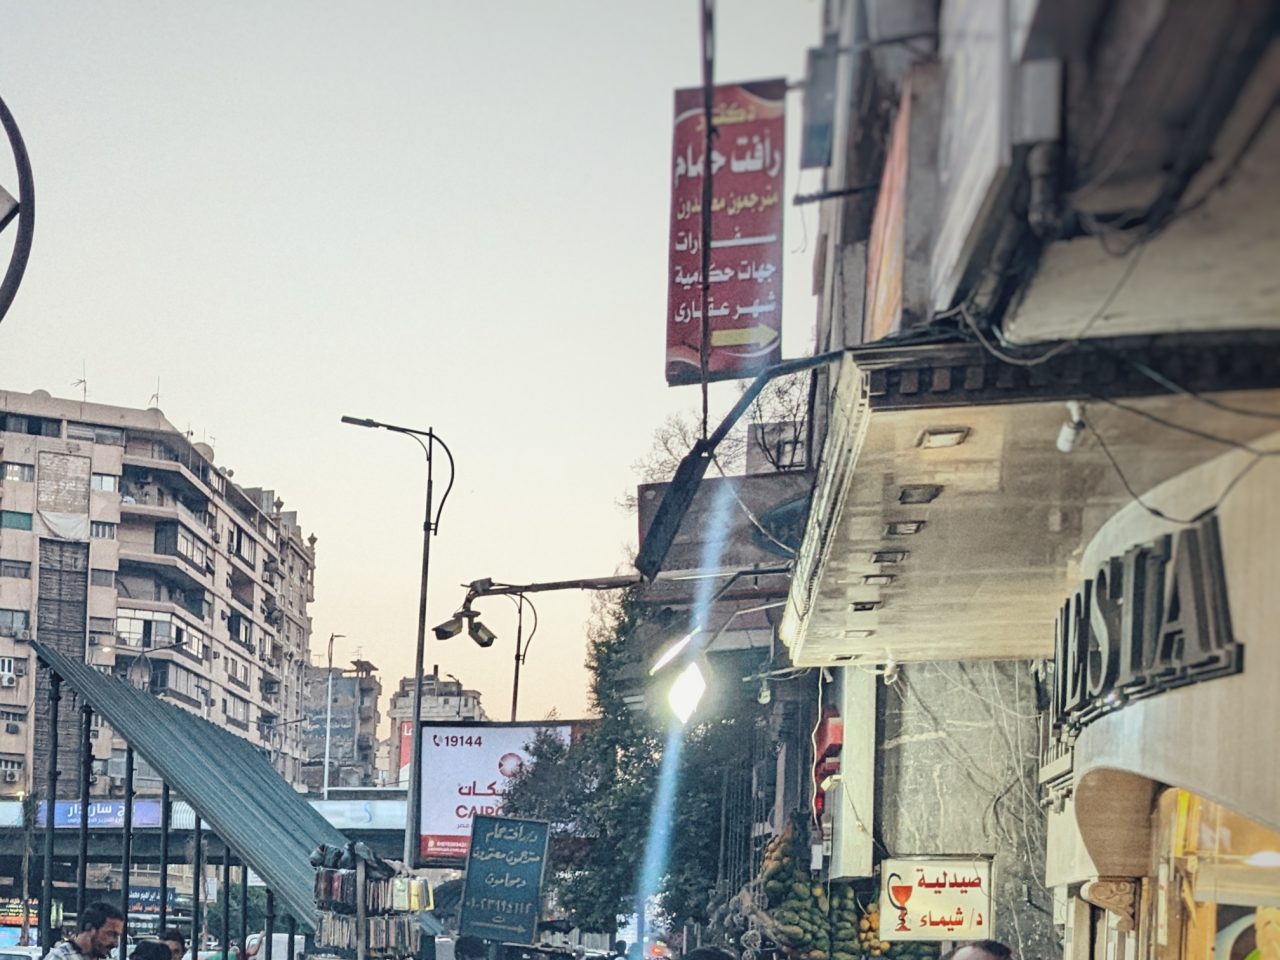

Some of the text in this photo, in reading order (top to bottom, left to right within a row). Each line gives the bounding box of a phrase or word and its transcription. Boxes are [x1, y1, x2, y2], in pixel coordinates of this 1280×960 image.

[677, 190, 780, 220] مترجمون معدون
[737, 259, 777, 282] جهات
[732, 292, 777, 321] شهر
[444, 735, 483, 747] 19144
[916, 868, 982, 895] صيدلية
[919, 907, 964, 932] شيماء
